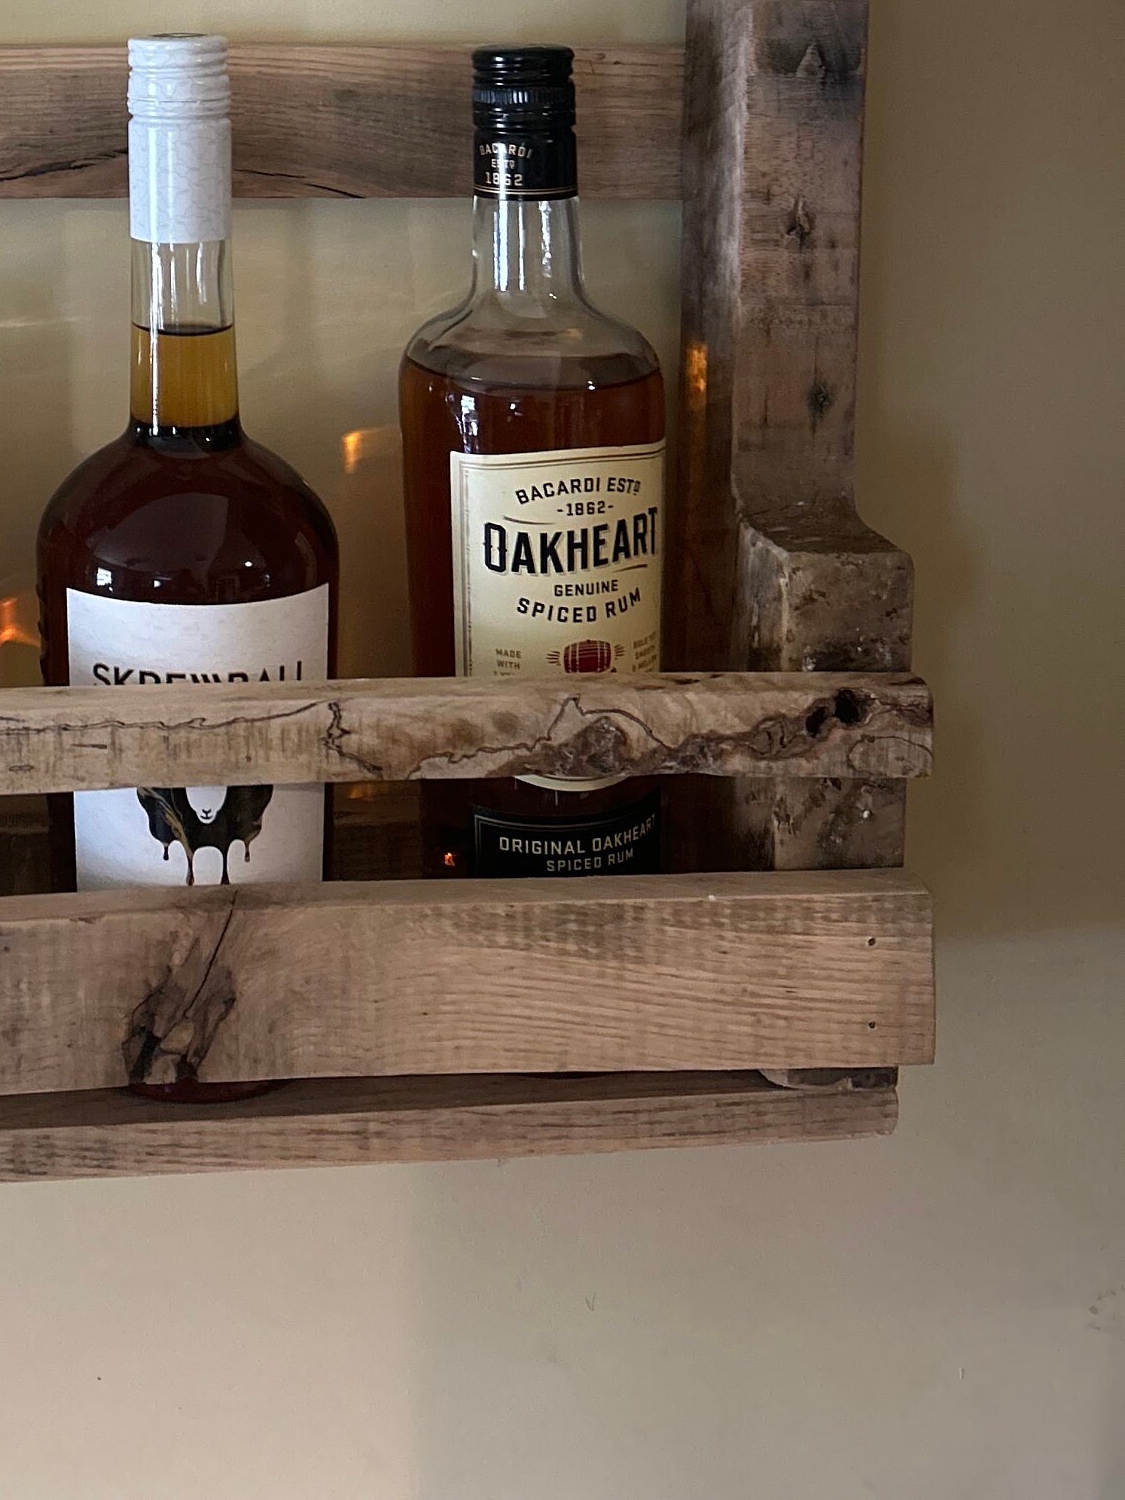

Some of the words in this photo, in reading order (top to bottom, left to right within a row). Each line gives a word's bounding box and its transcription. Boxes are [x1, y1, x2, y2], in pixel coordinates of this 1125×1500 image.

[485, 171, 523, 186] 1862
[515, 477, 601, 505] BACARDI
[483, 506, 658, 575] OAKHEART
[554, 579, 619, 597] GENUINE
[516, 597, 597, 623] SPICED
[605, 587, 641, 618] RUM
[496, 648, 522, 659] MADE
[497, 660, 521, 670] WITH
[499, 836, 586, 855] ORIGINAL
[592, 813, 656, 852] OAKHEART
[546, 857, 602, 872] SPICED
[608, 848, 634, 866] RUM
